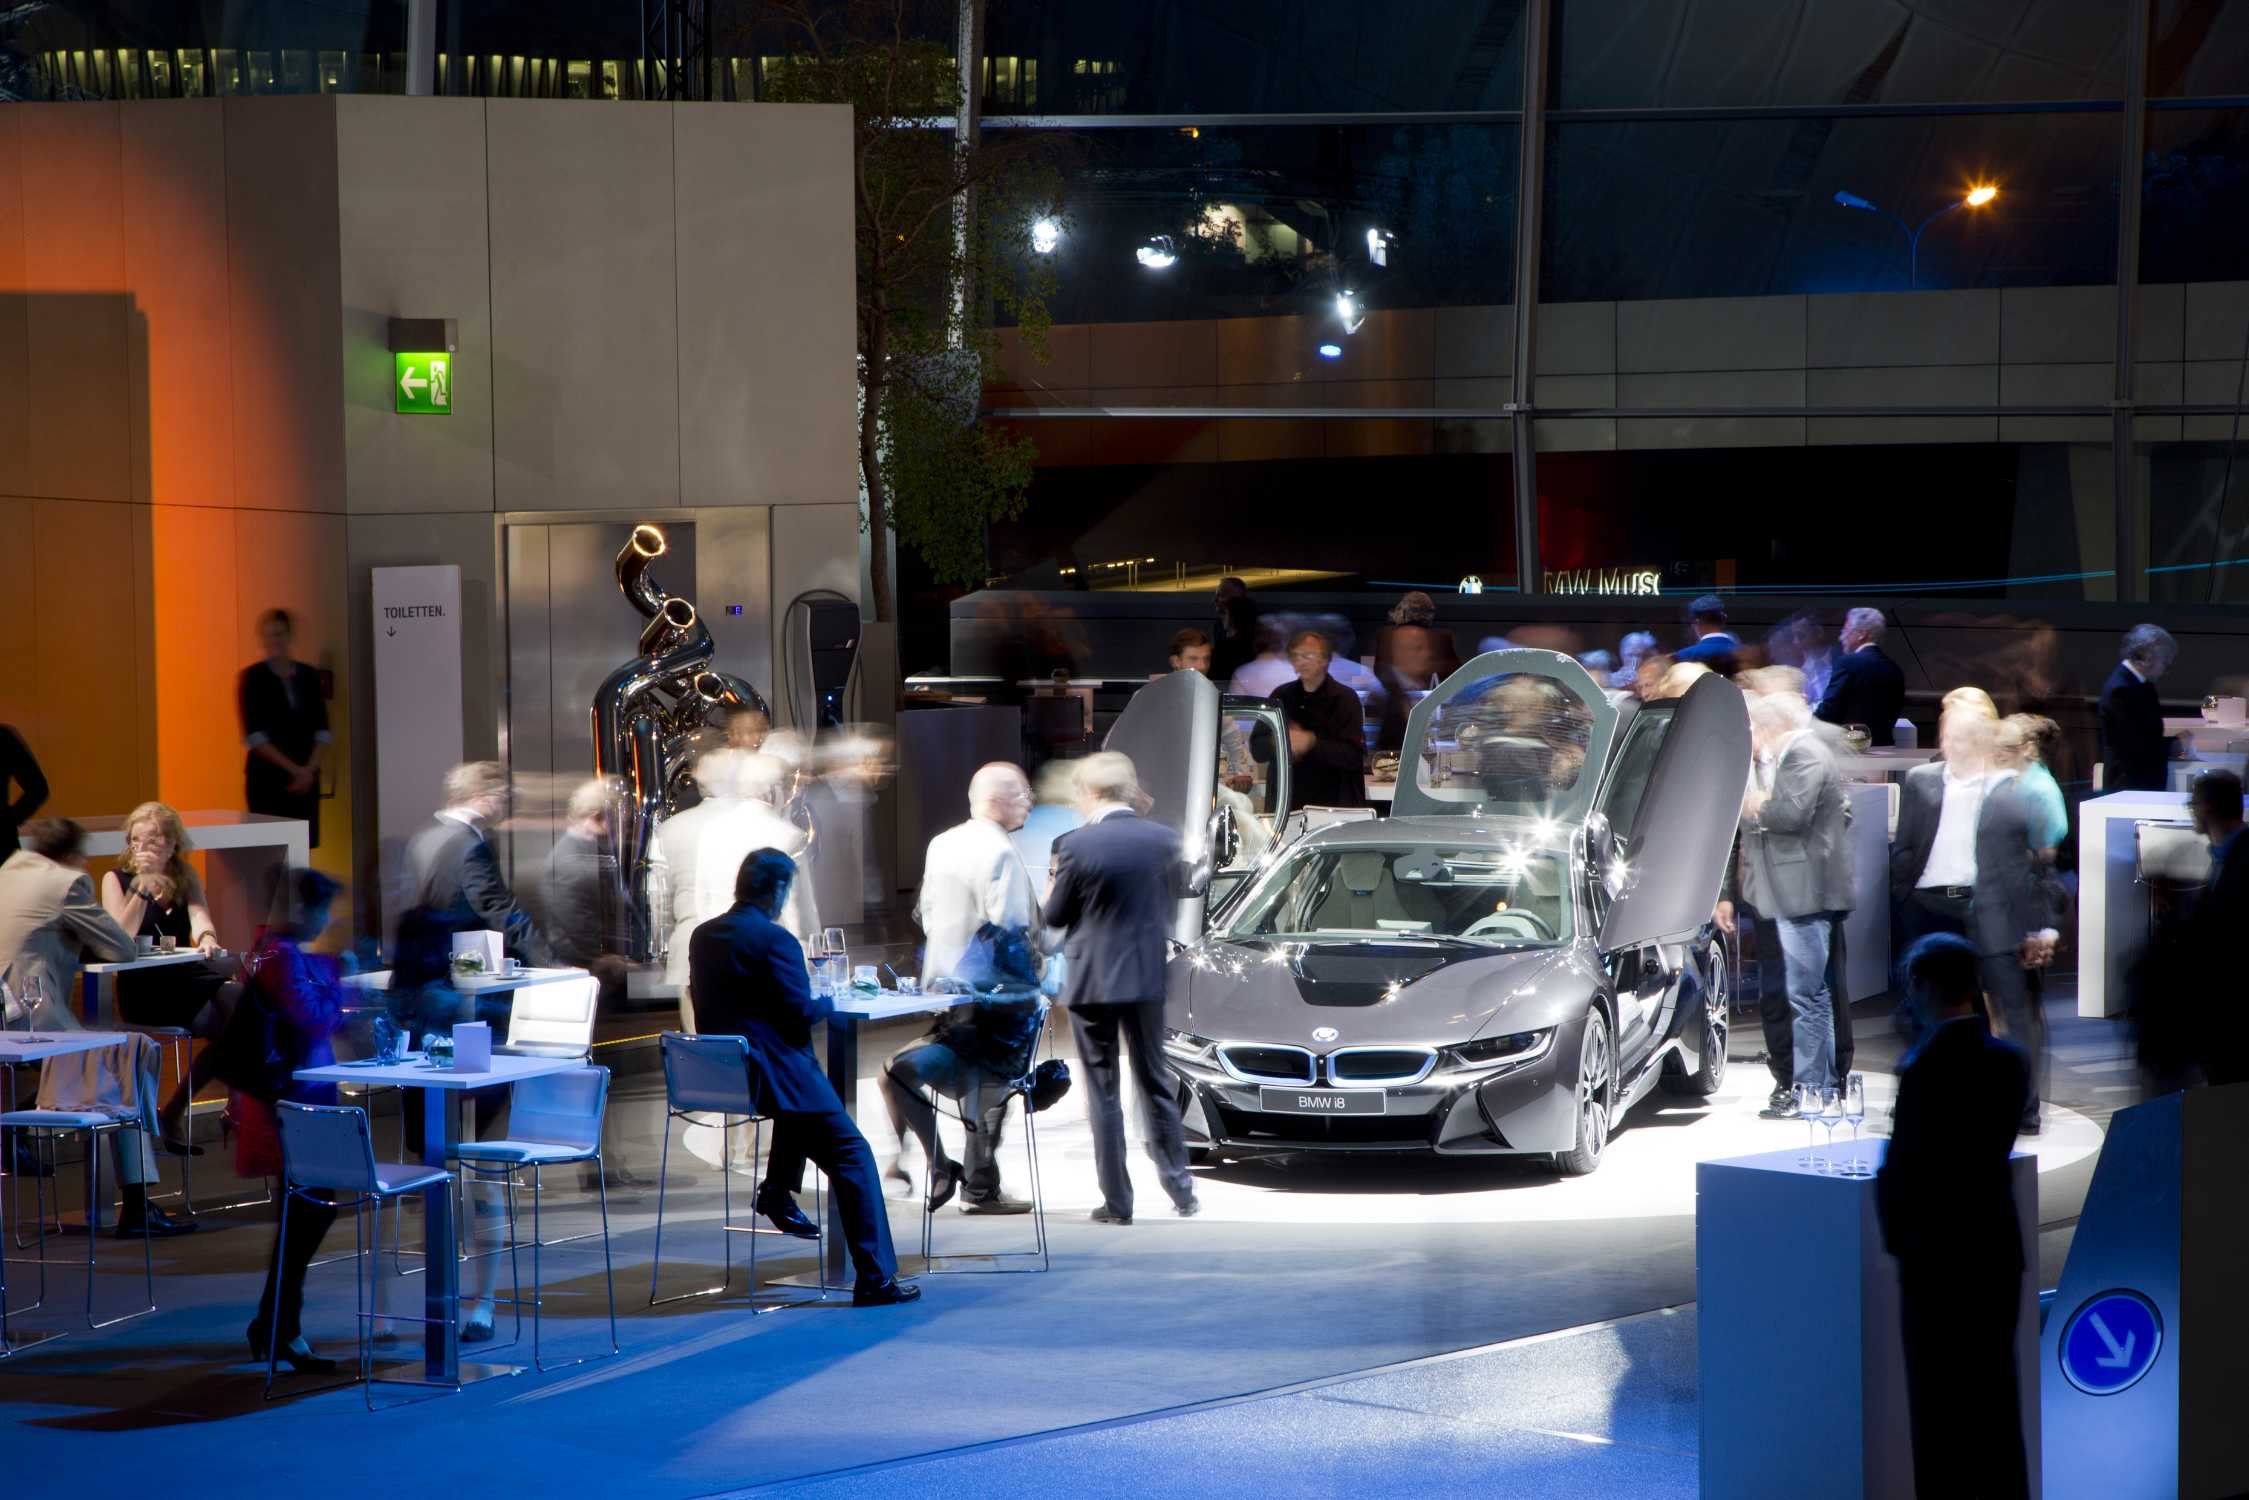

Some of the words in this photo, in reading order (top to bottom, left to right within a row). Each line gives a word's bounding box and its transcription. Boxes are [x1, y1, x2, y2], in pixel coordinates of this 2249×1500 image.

[1544, 568, 1591, 595] MW
[384, 605, 446, 618] TOILETTEN.
[1299, 1096, 1331, 1109] BMW
[1334, 1097, 1345, 1109] i8
